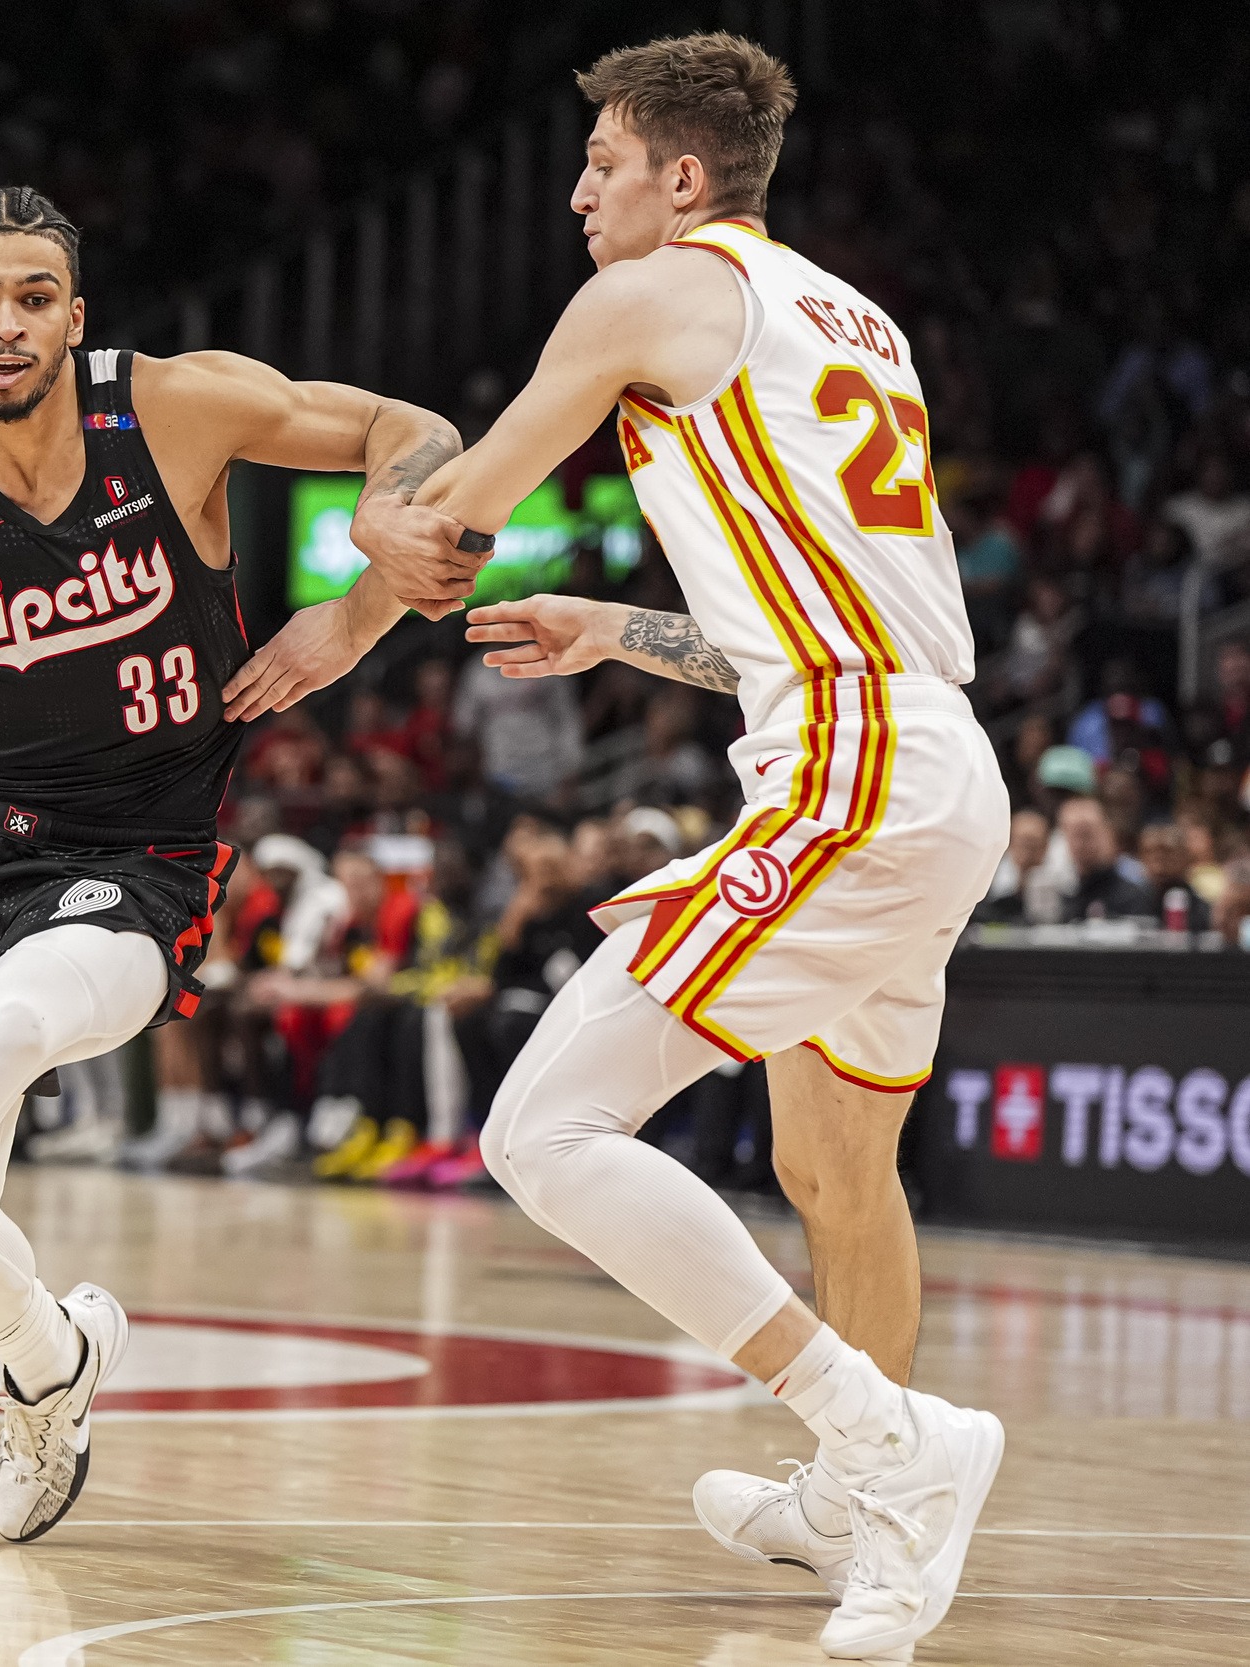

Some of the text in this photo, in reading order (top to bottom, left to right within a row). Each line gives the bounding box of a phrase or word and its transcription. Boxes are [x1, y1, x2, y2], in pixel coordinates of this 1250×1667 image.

[105, 415, 119, 428] 32
[94, 493, 154, 529] BRIGHTSIDE
[116, 645, 201, 735] 33
